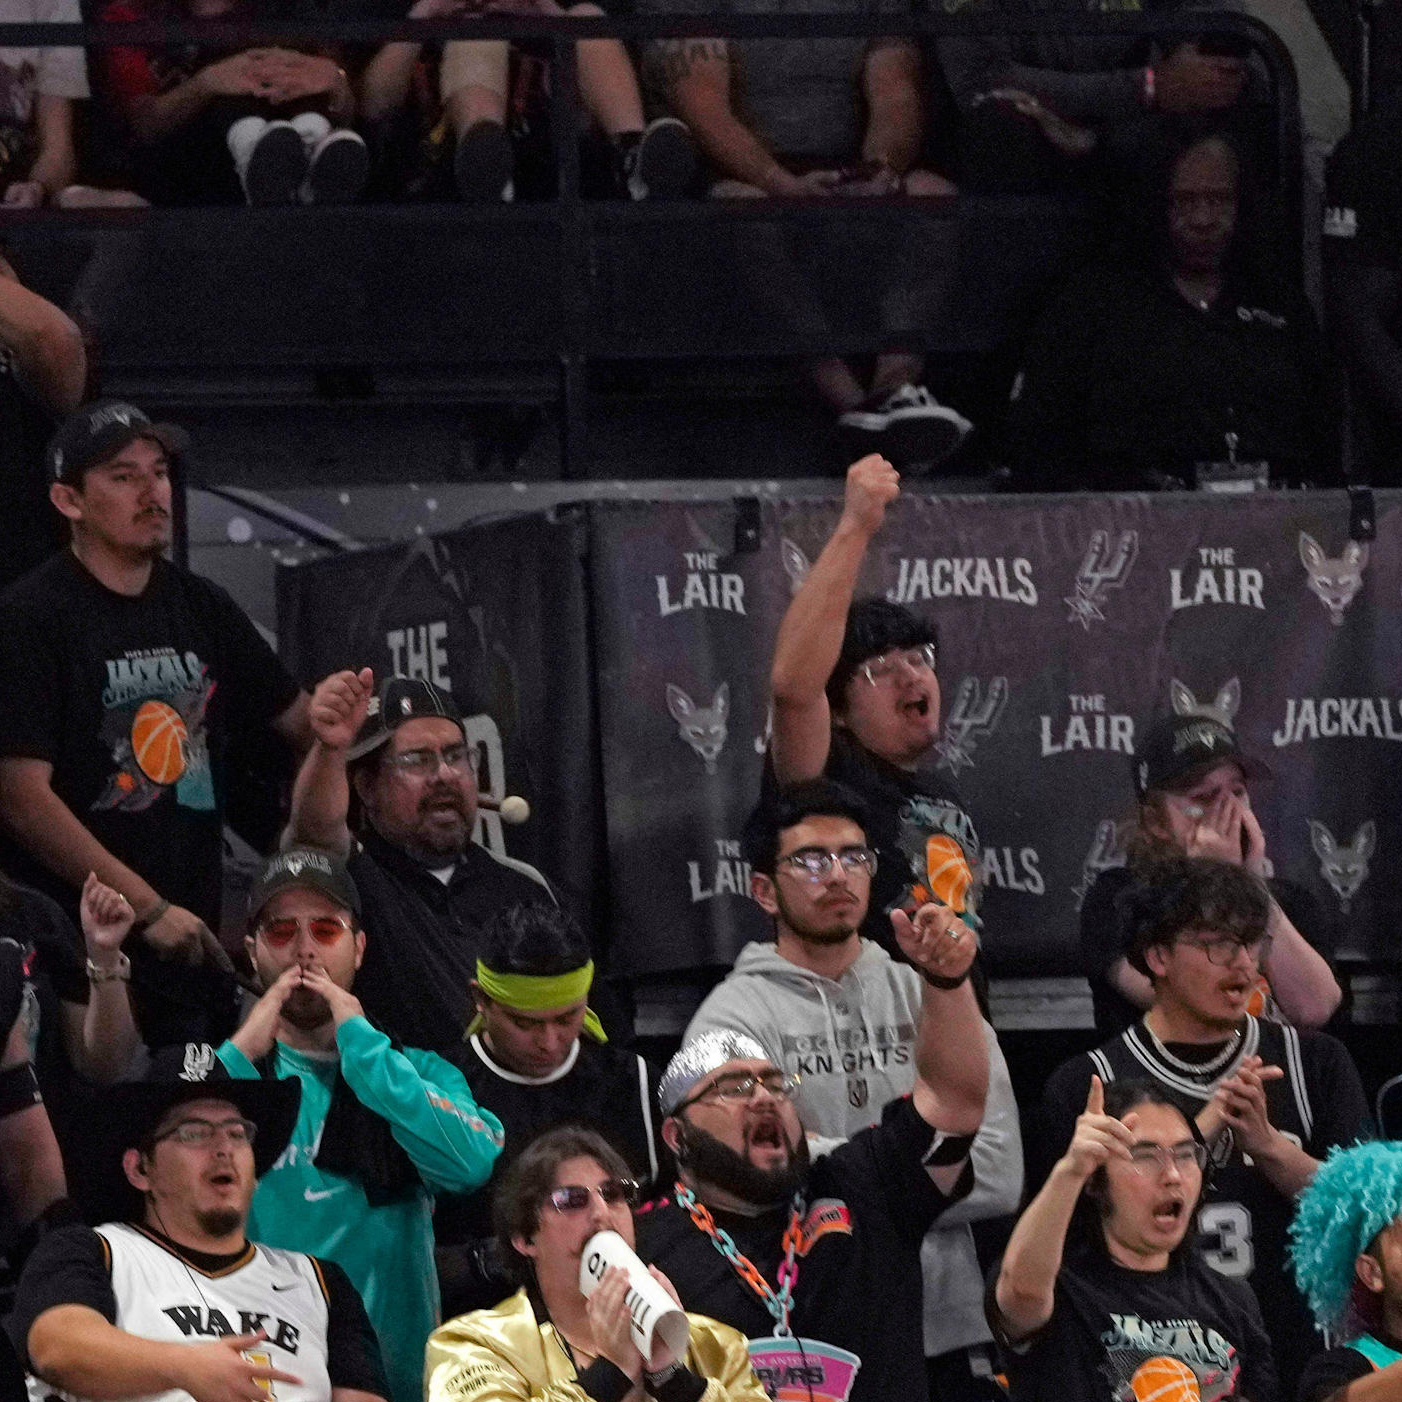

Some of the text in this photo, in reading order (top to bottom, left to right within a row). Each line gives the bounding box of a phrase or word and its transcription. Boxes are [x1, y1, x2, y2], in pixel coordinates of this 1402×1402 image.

[683, 551, 717, 571] THE
[1197, 547, 1235, 567] THE
[656, 573, 747, 616] LAIR
[886, 556, 1039, 606] JACKALS
[1169, 568, 1266, 610] LAIR
[387, 621, 448, 692] THE
[1069, 693, 1106, 713] THE
[1040, 714, 1135, 757] LAIR
[796, 1045, 911, 1076] KNGHTS
[1198, 1199, 1254, 1278] 3
[163, 1302, 300, 1355] WAKE
